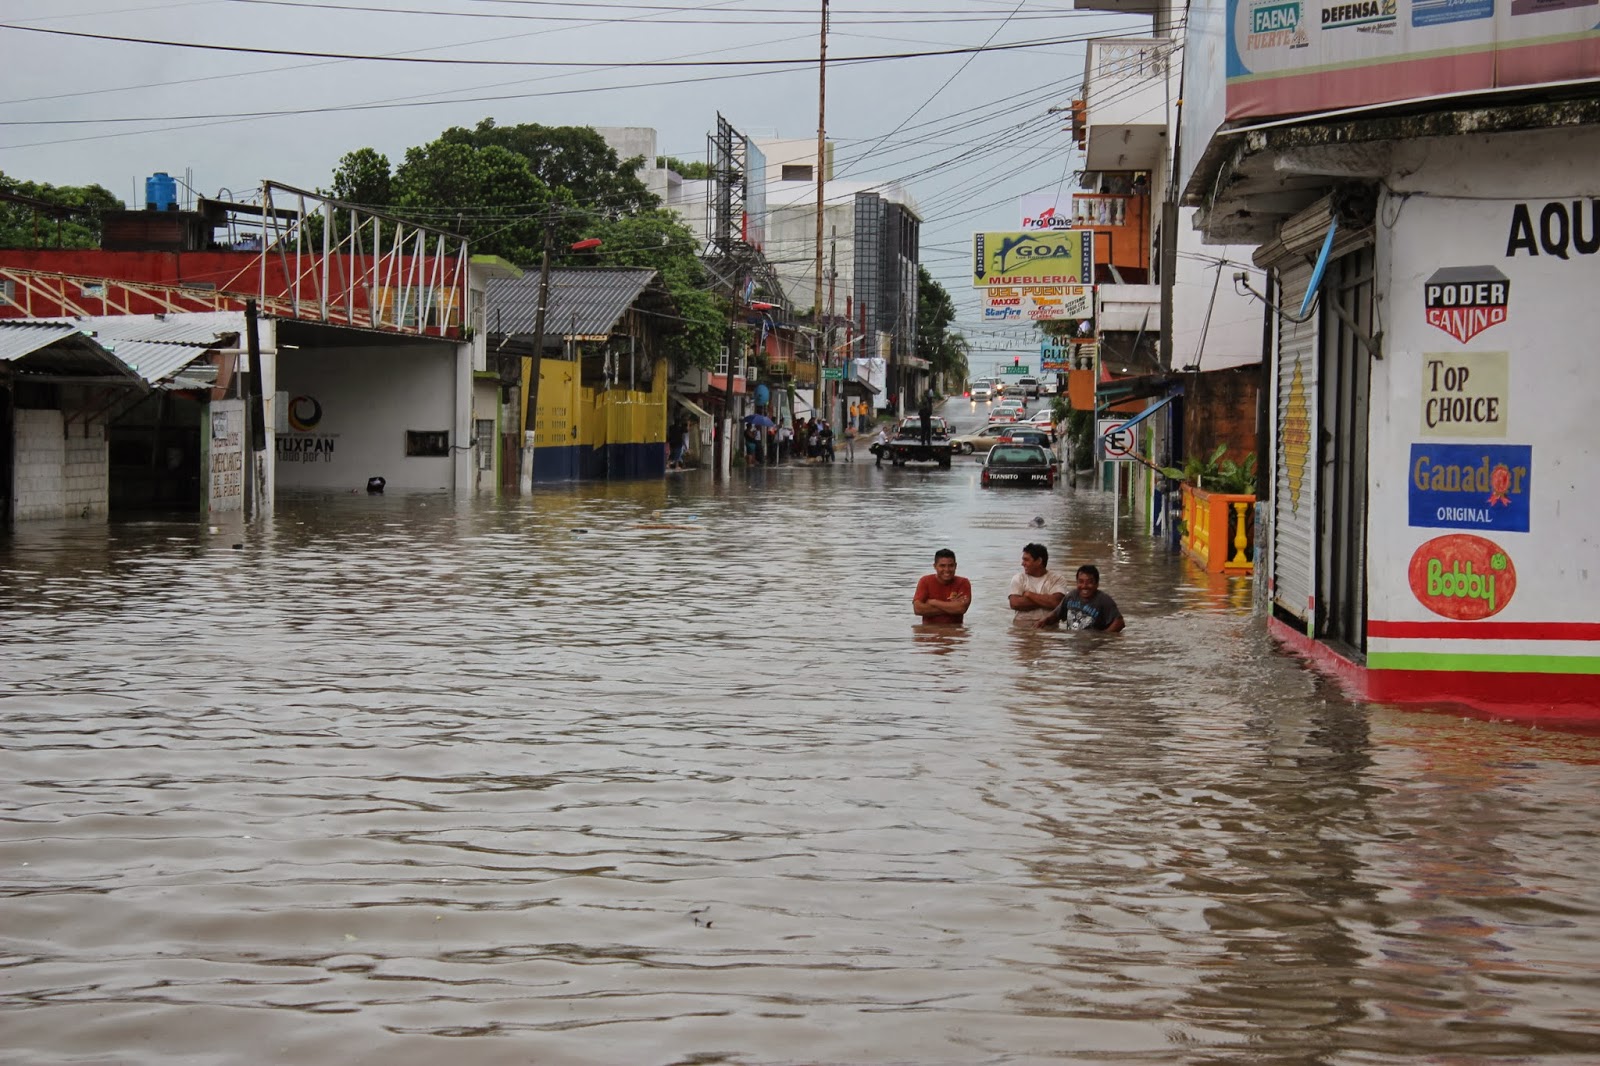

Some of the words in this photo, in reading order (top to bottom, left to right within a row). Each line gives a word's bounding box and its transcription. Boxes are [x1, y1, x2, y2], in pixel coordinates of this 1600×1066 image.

[1256, 7, 1297, 31] FAENA
[1321, 1, 1379, 24] DEFENSA
[1246, 30, 1293, 50] FUERTE
[1016, 244, 1070, 257] GOA
[989, 275, 1078, 285] MUEBLERIA
[1022, 286, 1084, 297] PUENTE
[1428, 283, 1505, 306] PODER
[991, 298, 1021, 306] MAXXIS
[985, 307, 1022, 319] Starfire
[1428, 307, 1505, 343] CANINO
[1426, 397, 1499, 429] CHOICE
[275, 437, 334, 453] TUXPAN
[303, 452, 319, 464] por
[1414, 455, 1526, 496] Ganador
[1437, 506, 1493, 523] ORIGINAL
[1427, 558, 1495, 611] Bobby
